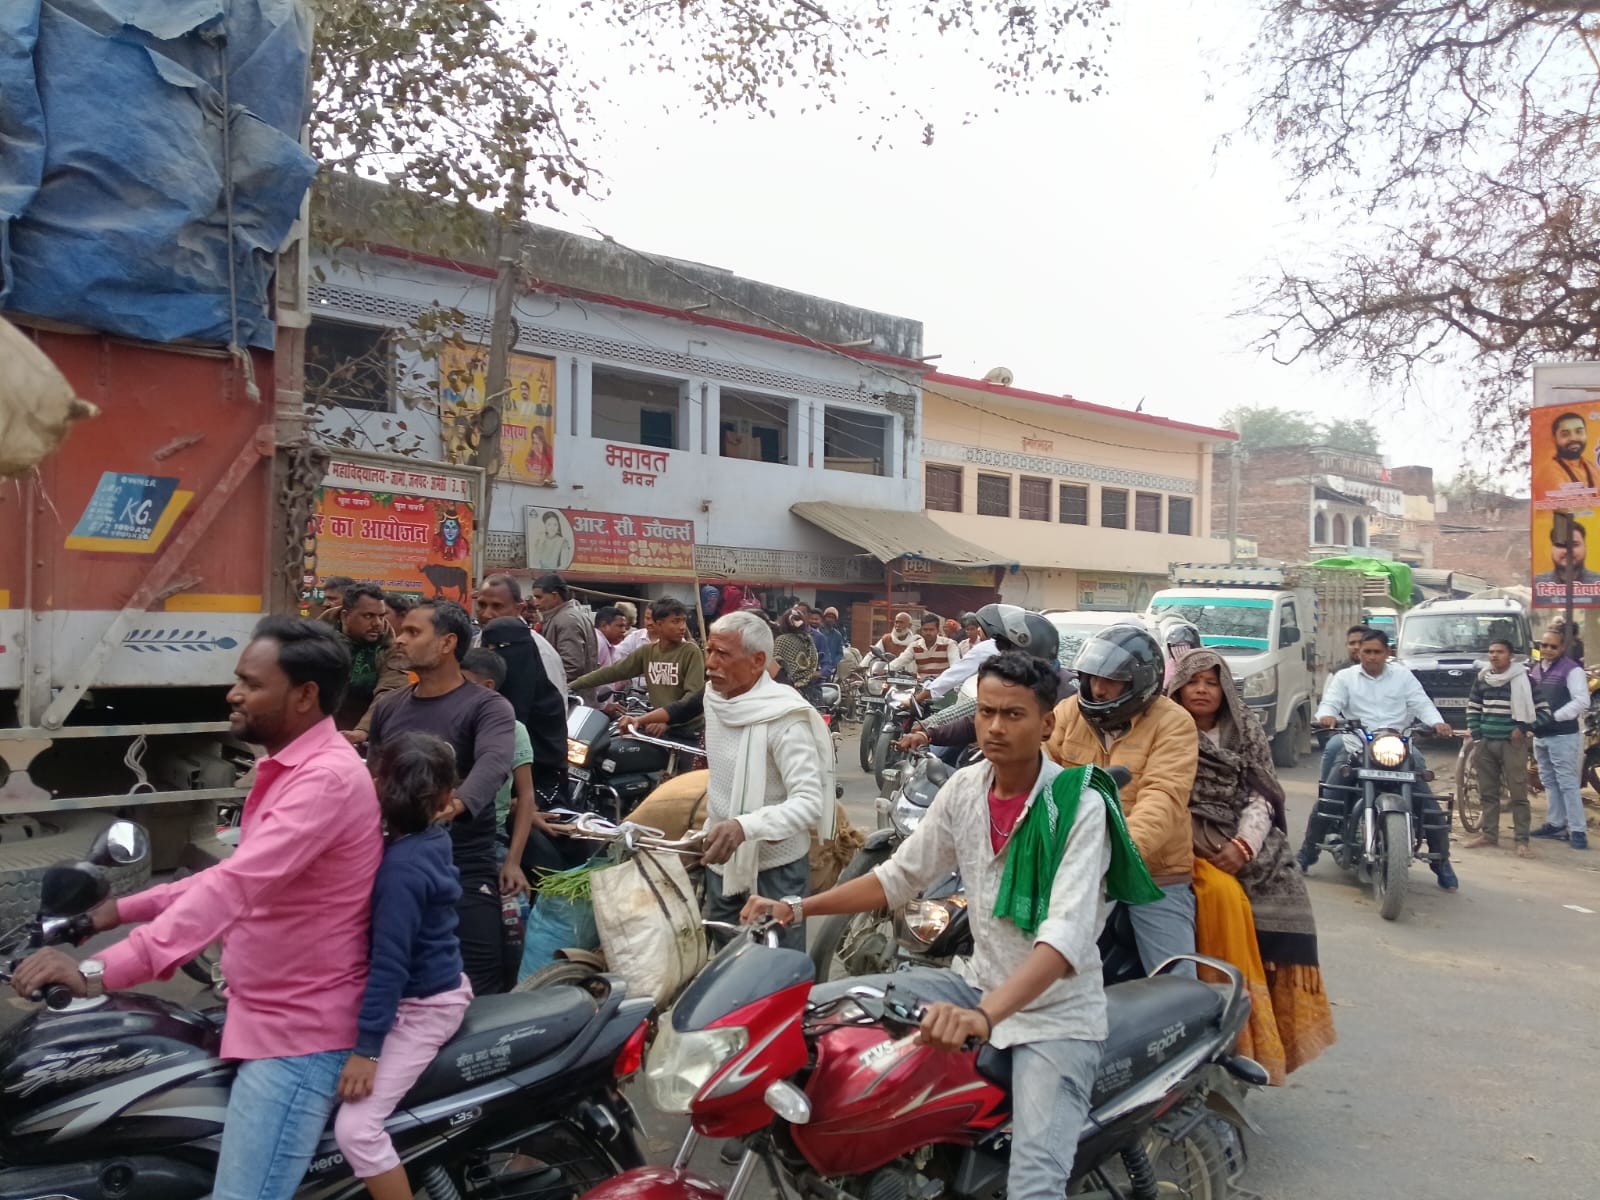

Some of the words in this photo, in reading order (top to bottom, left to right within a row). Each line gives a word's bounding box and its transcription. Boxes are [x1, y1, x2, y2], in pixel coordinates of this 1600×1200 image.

[605, 444, 670, 472] भगवत
[622, 470, 658, 487] भवन
[329, 515, 355, 538] का
[360, 515, 430, 543] आयोजन
[648, 661, 679, 674] NORTH
[859, 1039, 894, 1067] TVS
[309, 1153, 344, 1173] Hero
